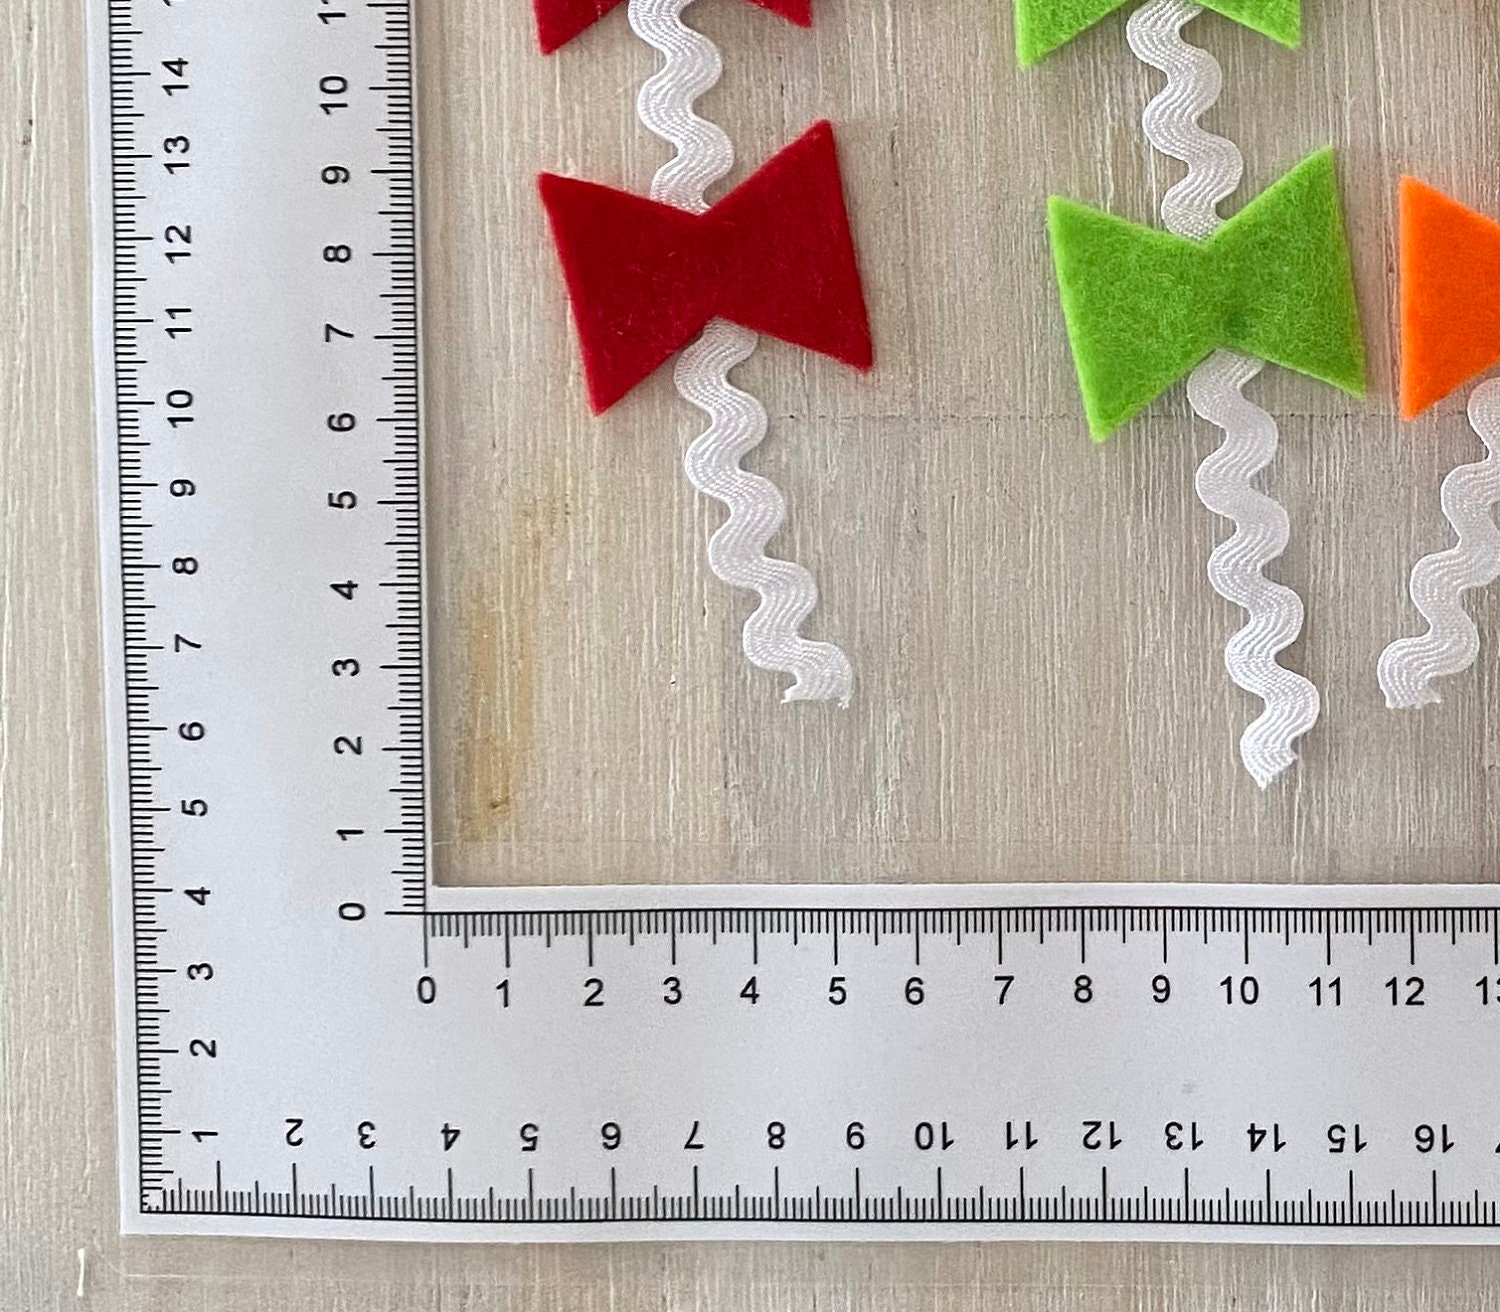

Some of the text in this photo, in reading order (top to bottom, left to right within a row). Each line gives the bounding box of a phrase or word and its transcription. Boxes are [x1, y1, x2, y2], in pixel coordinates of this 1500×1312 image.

[161, 57, 190, 97] 14
[319, 75, 349, 116] 10
[162, 135, 191, 175] 13
[320, 165, 351, 185] 9
[164, 225, 192, 265] 12
[322, 244, 352, 264] 8
[164, 307, 193, 340] 11
[324, 323, 355, 343] 7
[166, 389, 195, 429] 10
[326, 412, 356, 433] 6
[169, 479, 197, 498] 9
[327, 490, 358, 510] 5
[171, 556, 199, 576] 8
[329, 579, 359, 601] 4
[174, 633, 202, 653] 7
[331, 658, 361, 677] 3
[178, 721, 205, 742] 6
[333, 736, 363, 756] 2
[180, 799, 208, 817] 5
[335, 829, 365, 842] 1
[183, 886, 211, 906] 4
[338, 902, 366, 922] 0
[186, 962, 214, 981] 3
[416, 975, 437, 1005] 0
[495, 978, 510, 1009] 1
[583, 977, 605, 1007] 2
[662, 976, 683, 1006] 3
[739, 975, 761, 1005] 4
[828, 976, 847, 1006] 5
[904, 976, 925, 1006] 6
[994, 975, 1015, 1006] 7
[1073, 974, 1094, 1004] 8
[1151, 974, 1171, 1004] 9
[1220, 975, 1260, 1006] 10
[1308, 976, 1341, 1007] 11
[1384, 976, 1425, 1007] 12
[189, 1039, 217, 1059] 2
[191, 1130, 219, 1143] 1
[285, 1118, 304, 1147] 2
[357, 1120, 376, 1150] 3
[440, 1122, 461, 1152] 4
[519, 1122, 539, 1152] 5
[600, 1121, 622, 1151] 6
[683, 1120, 705, 1150] 7
[766, 1121, 786, 1150] 8
[846, 1121, 865, 1150] 9
[914, 1121, 955, 1151] 10
[1005, 1120, 1039, 1151] 11
[1082, 1120, 1123, 1151] 12
[1164, 1121, 1204, 1151] 13
[1246, 1122, 1287, 1153] 14
[1327, 1123, 1368, 1154] 15
[1414, 1123, 1455, 1154] 16
